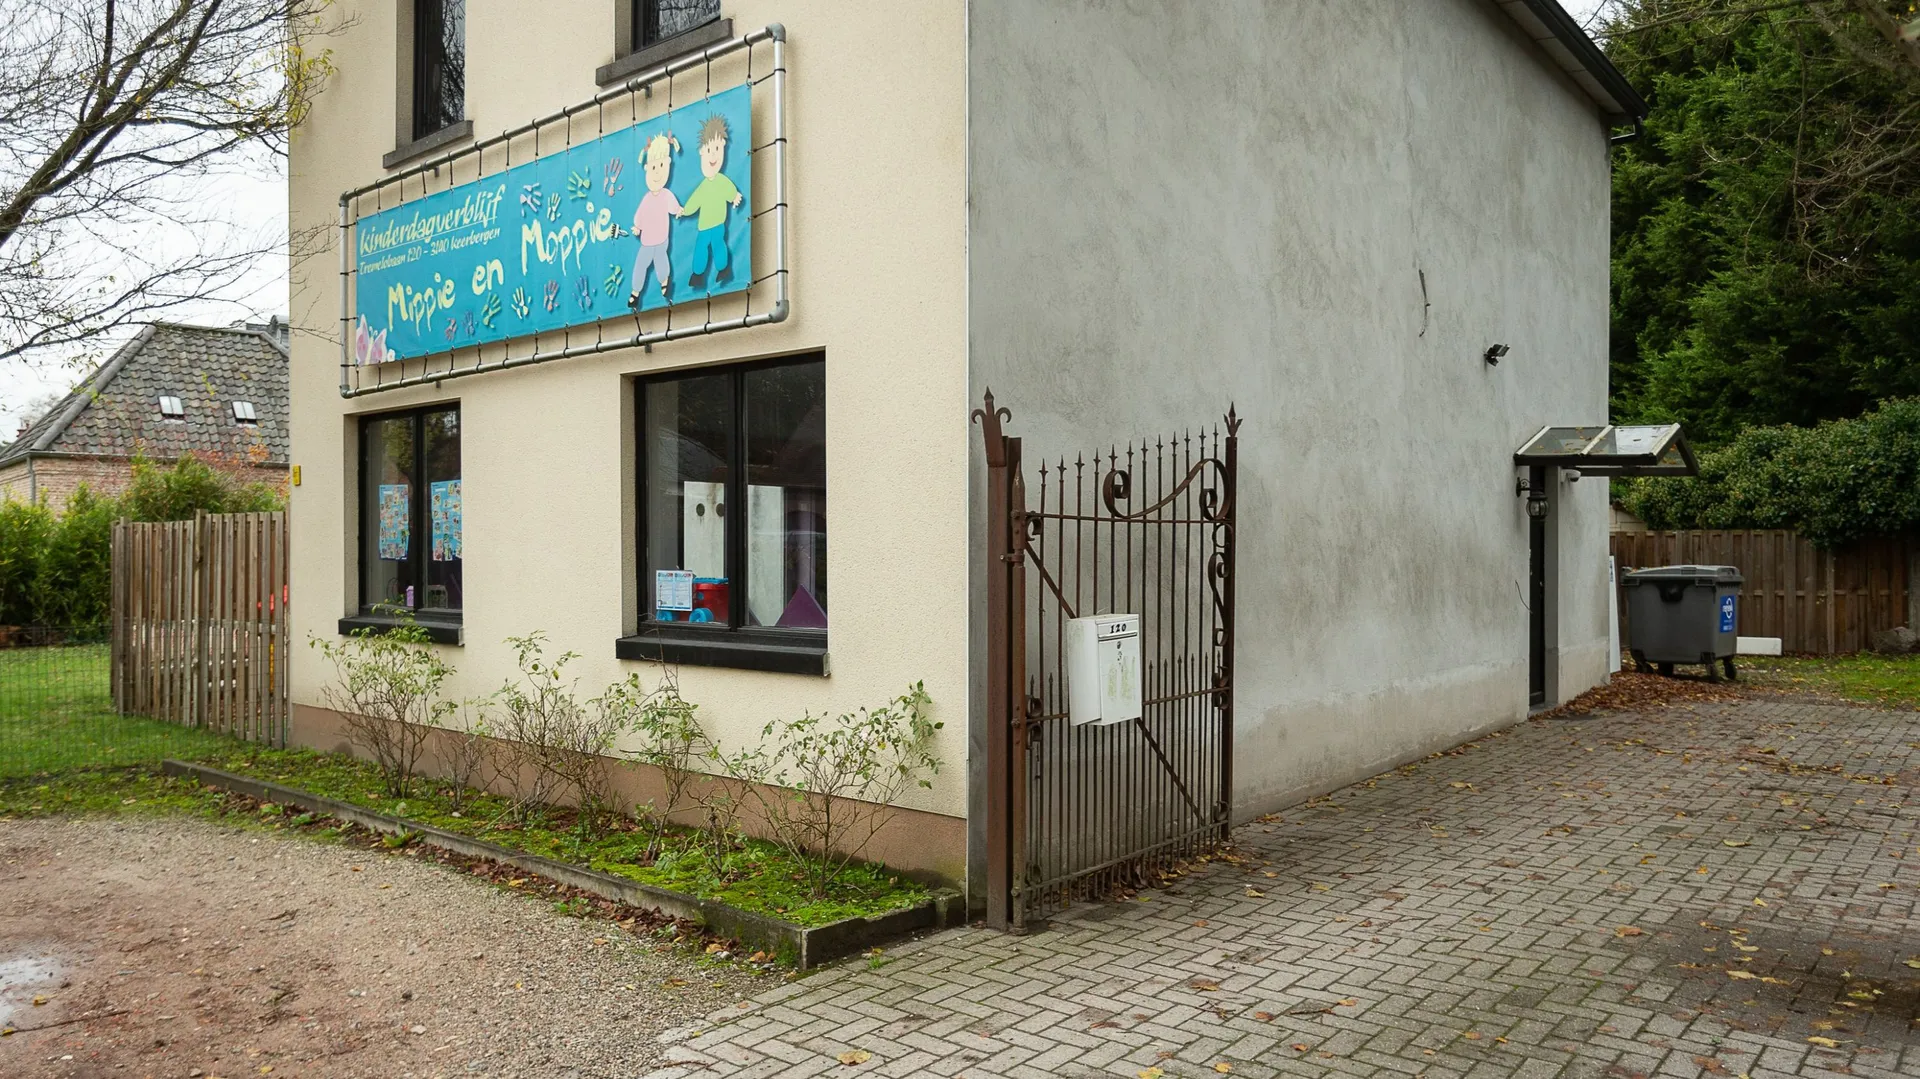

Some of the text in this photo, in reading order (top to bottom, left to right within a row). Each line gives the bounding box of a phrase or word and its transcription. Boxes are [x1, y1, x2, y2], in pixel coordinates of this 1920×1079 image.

[407, 246, 422, 262] 120
[388, 201, 612, 337] Mippie en Moppie
[1109, 623, 1127, 634] 120
